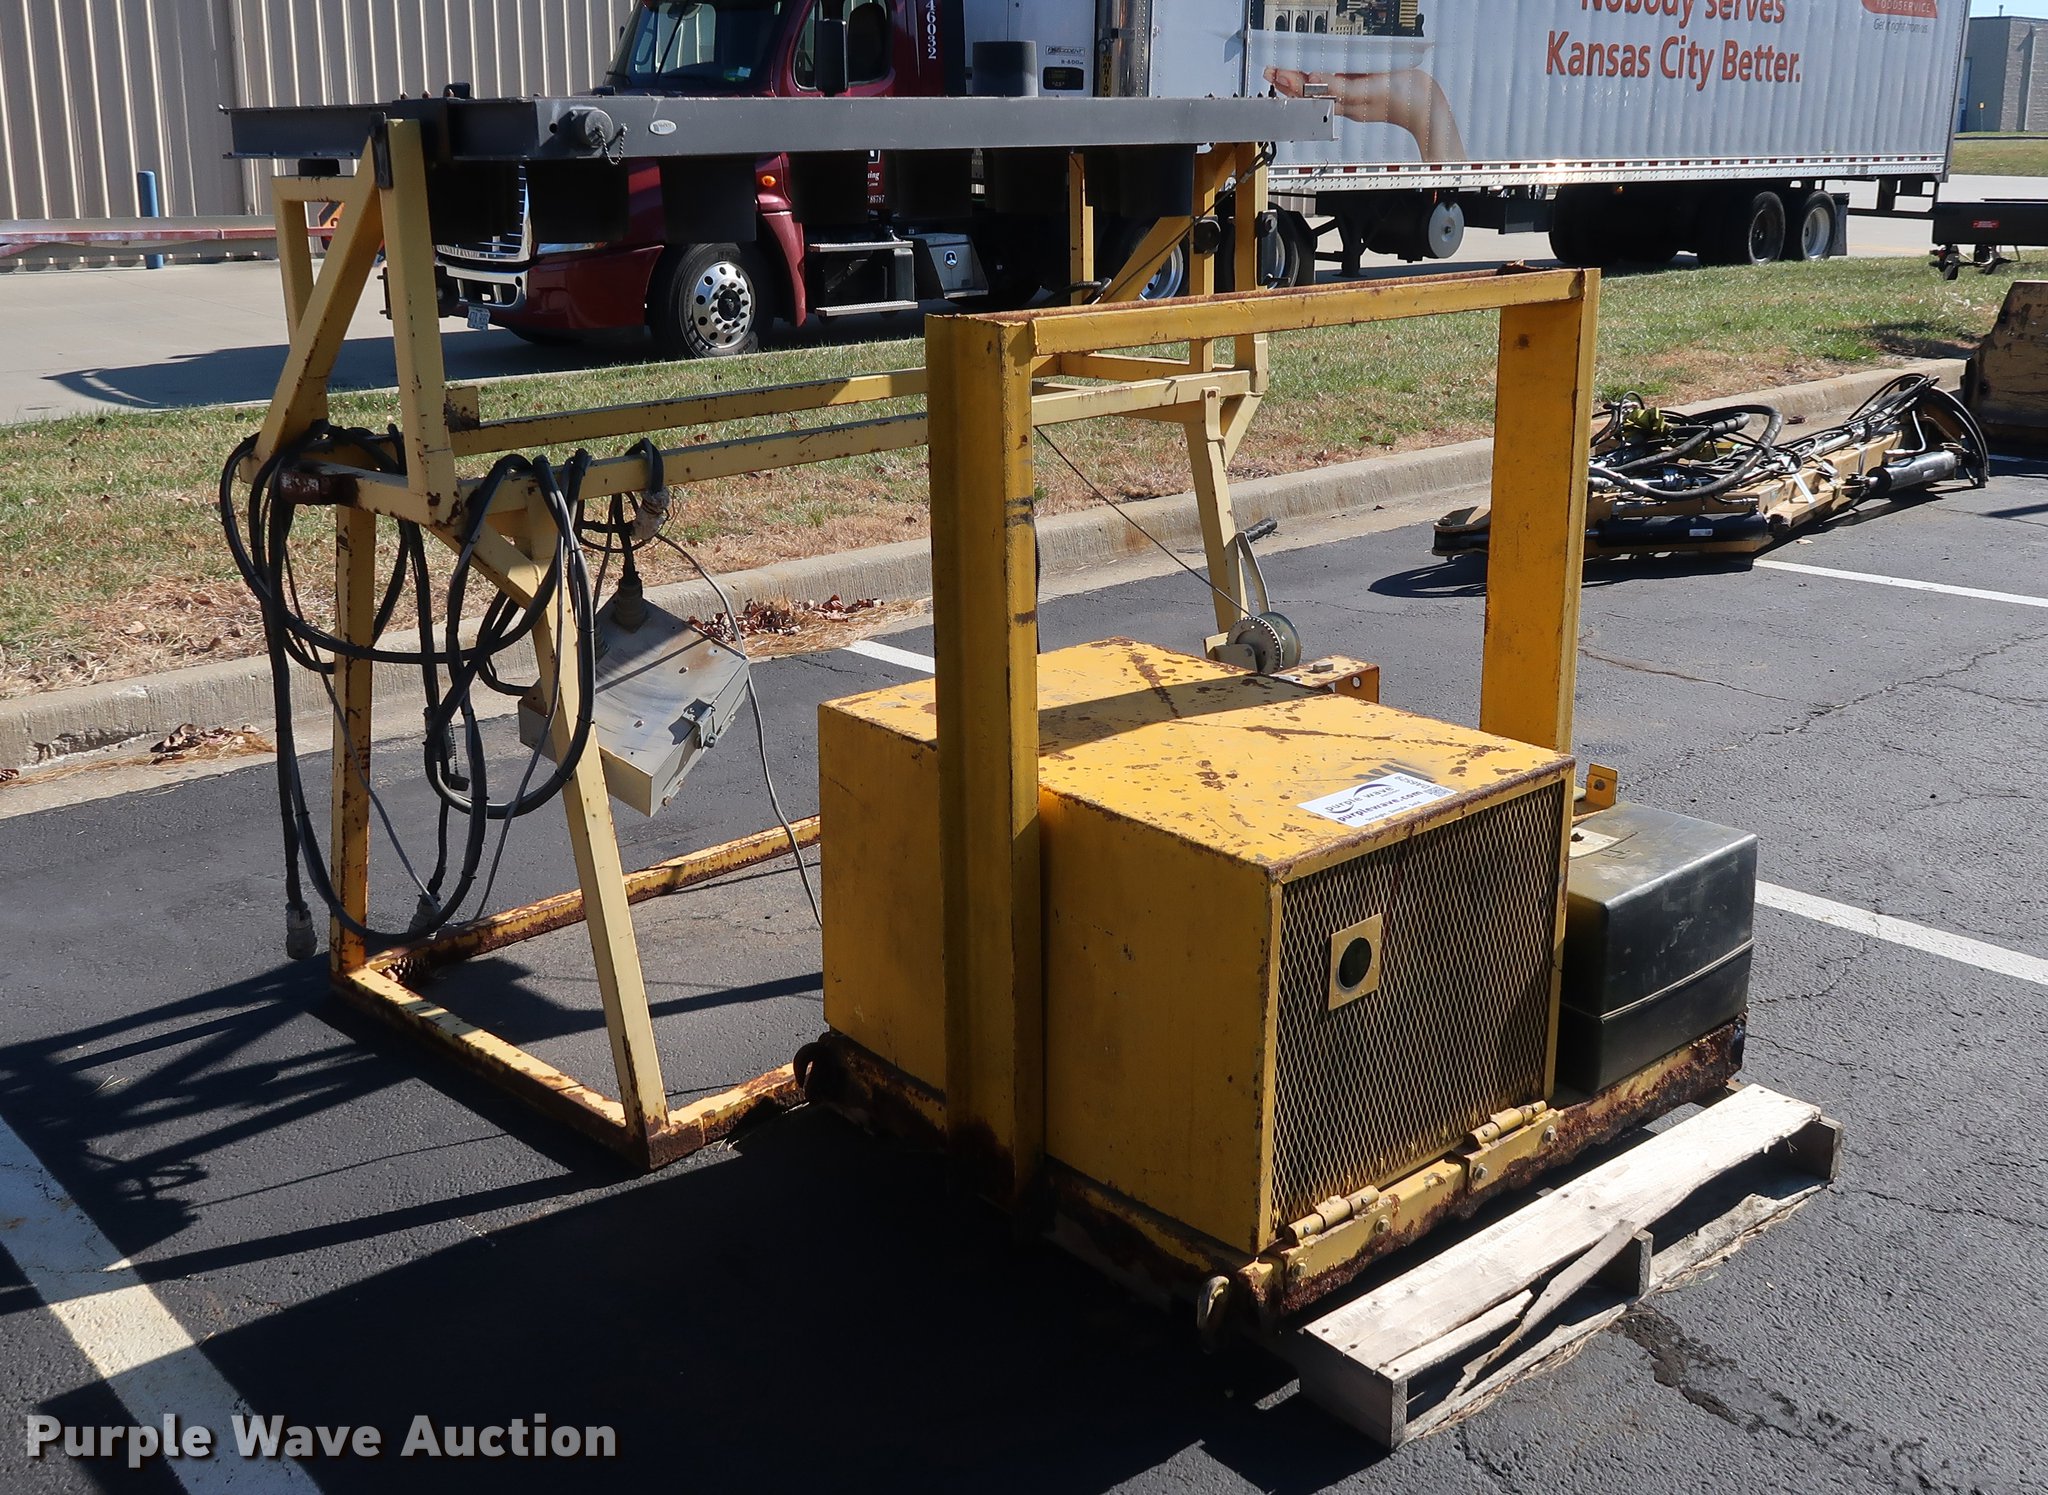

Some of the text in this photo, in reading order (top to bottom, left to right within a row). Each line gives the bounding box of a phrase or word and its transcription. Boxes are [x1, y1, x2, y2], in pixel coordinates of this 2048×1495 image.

[1546, 31, 1801, 91] Kansas City Better.
[1324, 797, 1362, 811] purple
[1363, 787, 1395, 798] wave
[1337, 791, 1423, 822] purplewave.com
